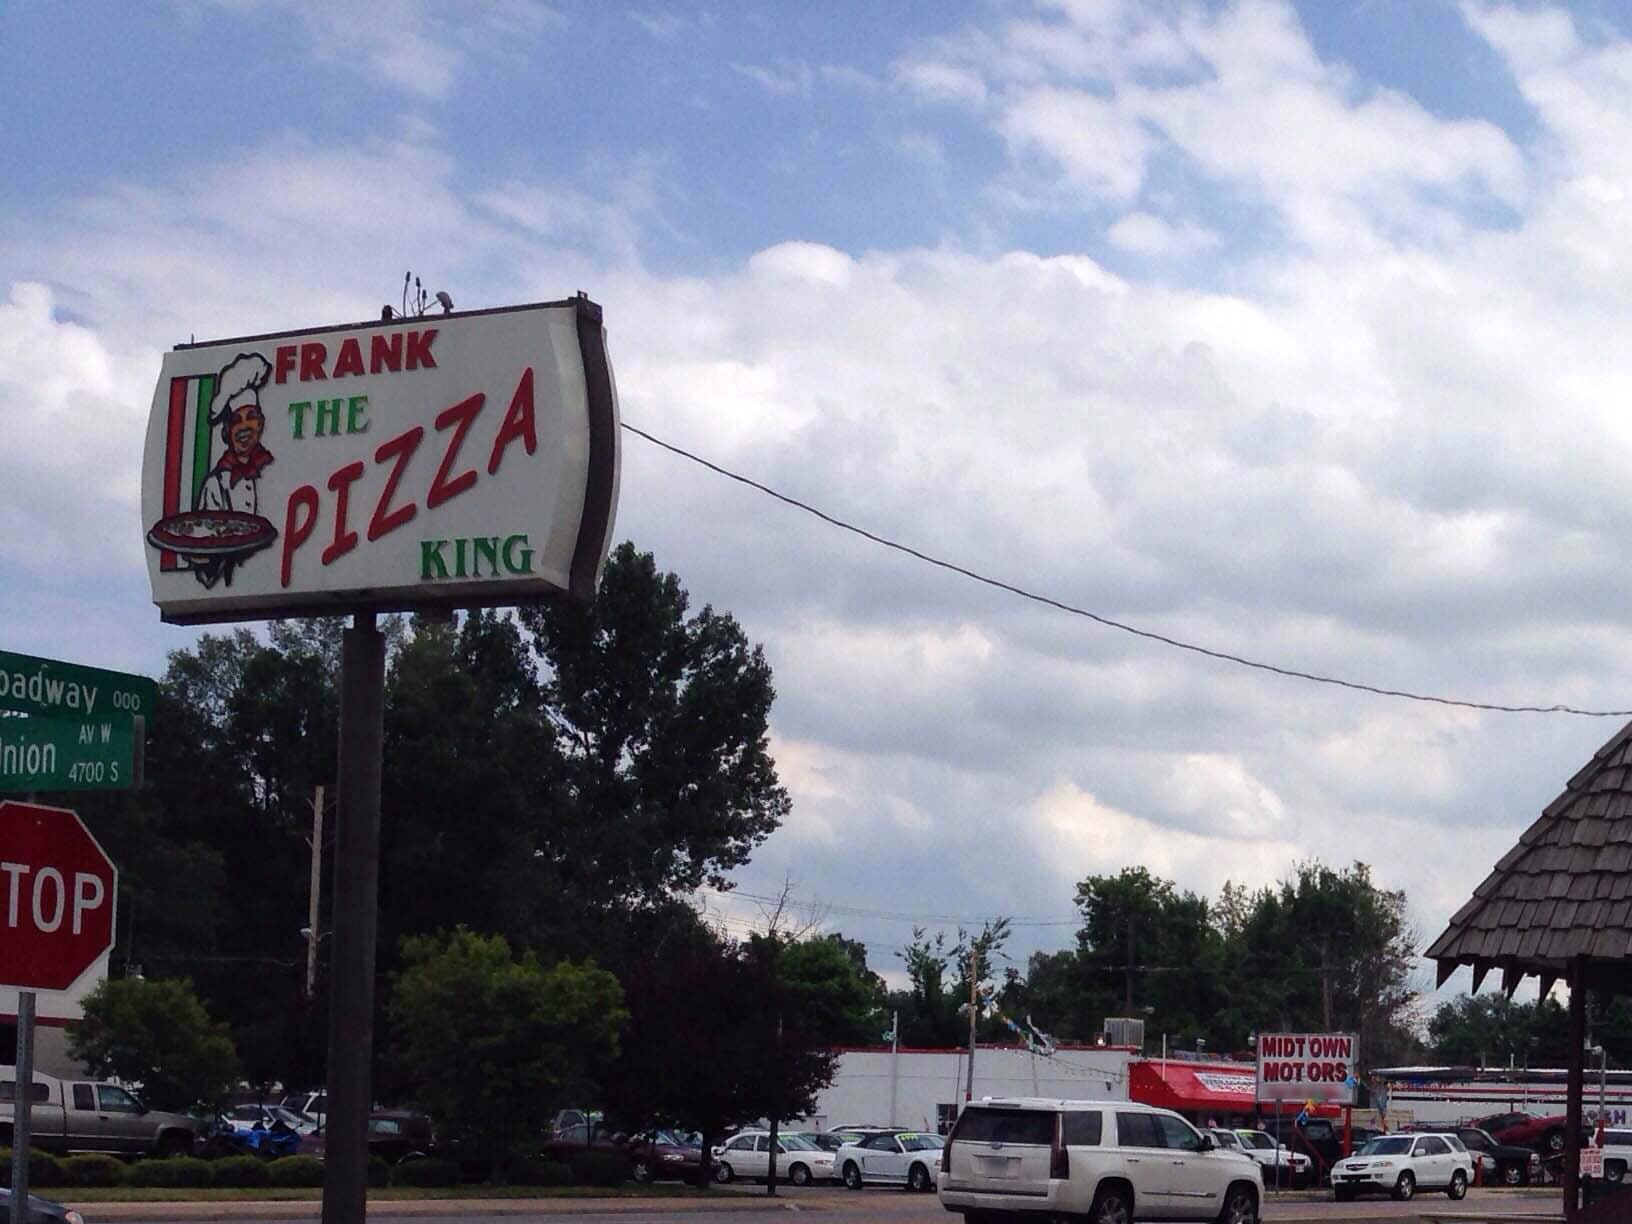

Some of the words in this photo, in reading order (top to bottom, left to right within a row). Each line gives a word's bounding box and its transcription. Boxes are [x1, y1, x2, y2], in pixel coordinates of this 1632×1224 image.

[275, 329, 438, 384] FRANK
[288, 395, 369, 439] THE
[280, 366, 538, 588] PIZZA
[420, 534, 535, 580] KING
[112, 690, 141, 711] 000
[79, 724, 95, 745] AV
[100, 722, 112, 744] W
[0, 735, 57, 775] nion
[68, 761, 105, 783] 4700
[110, 761, 120, 783] S
[1263, 1062, 1348, 1082] MOTORS
